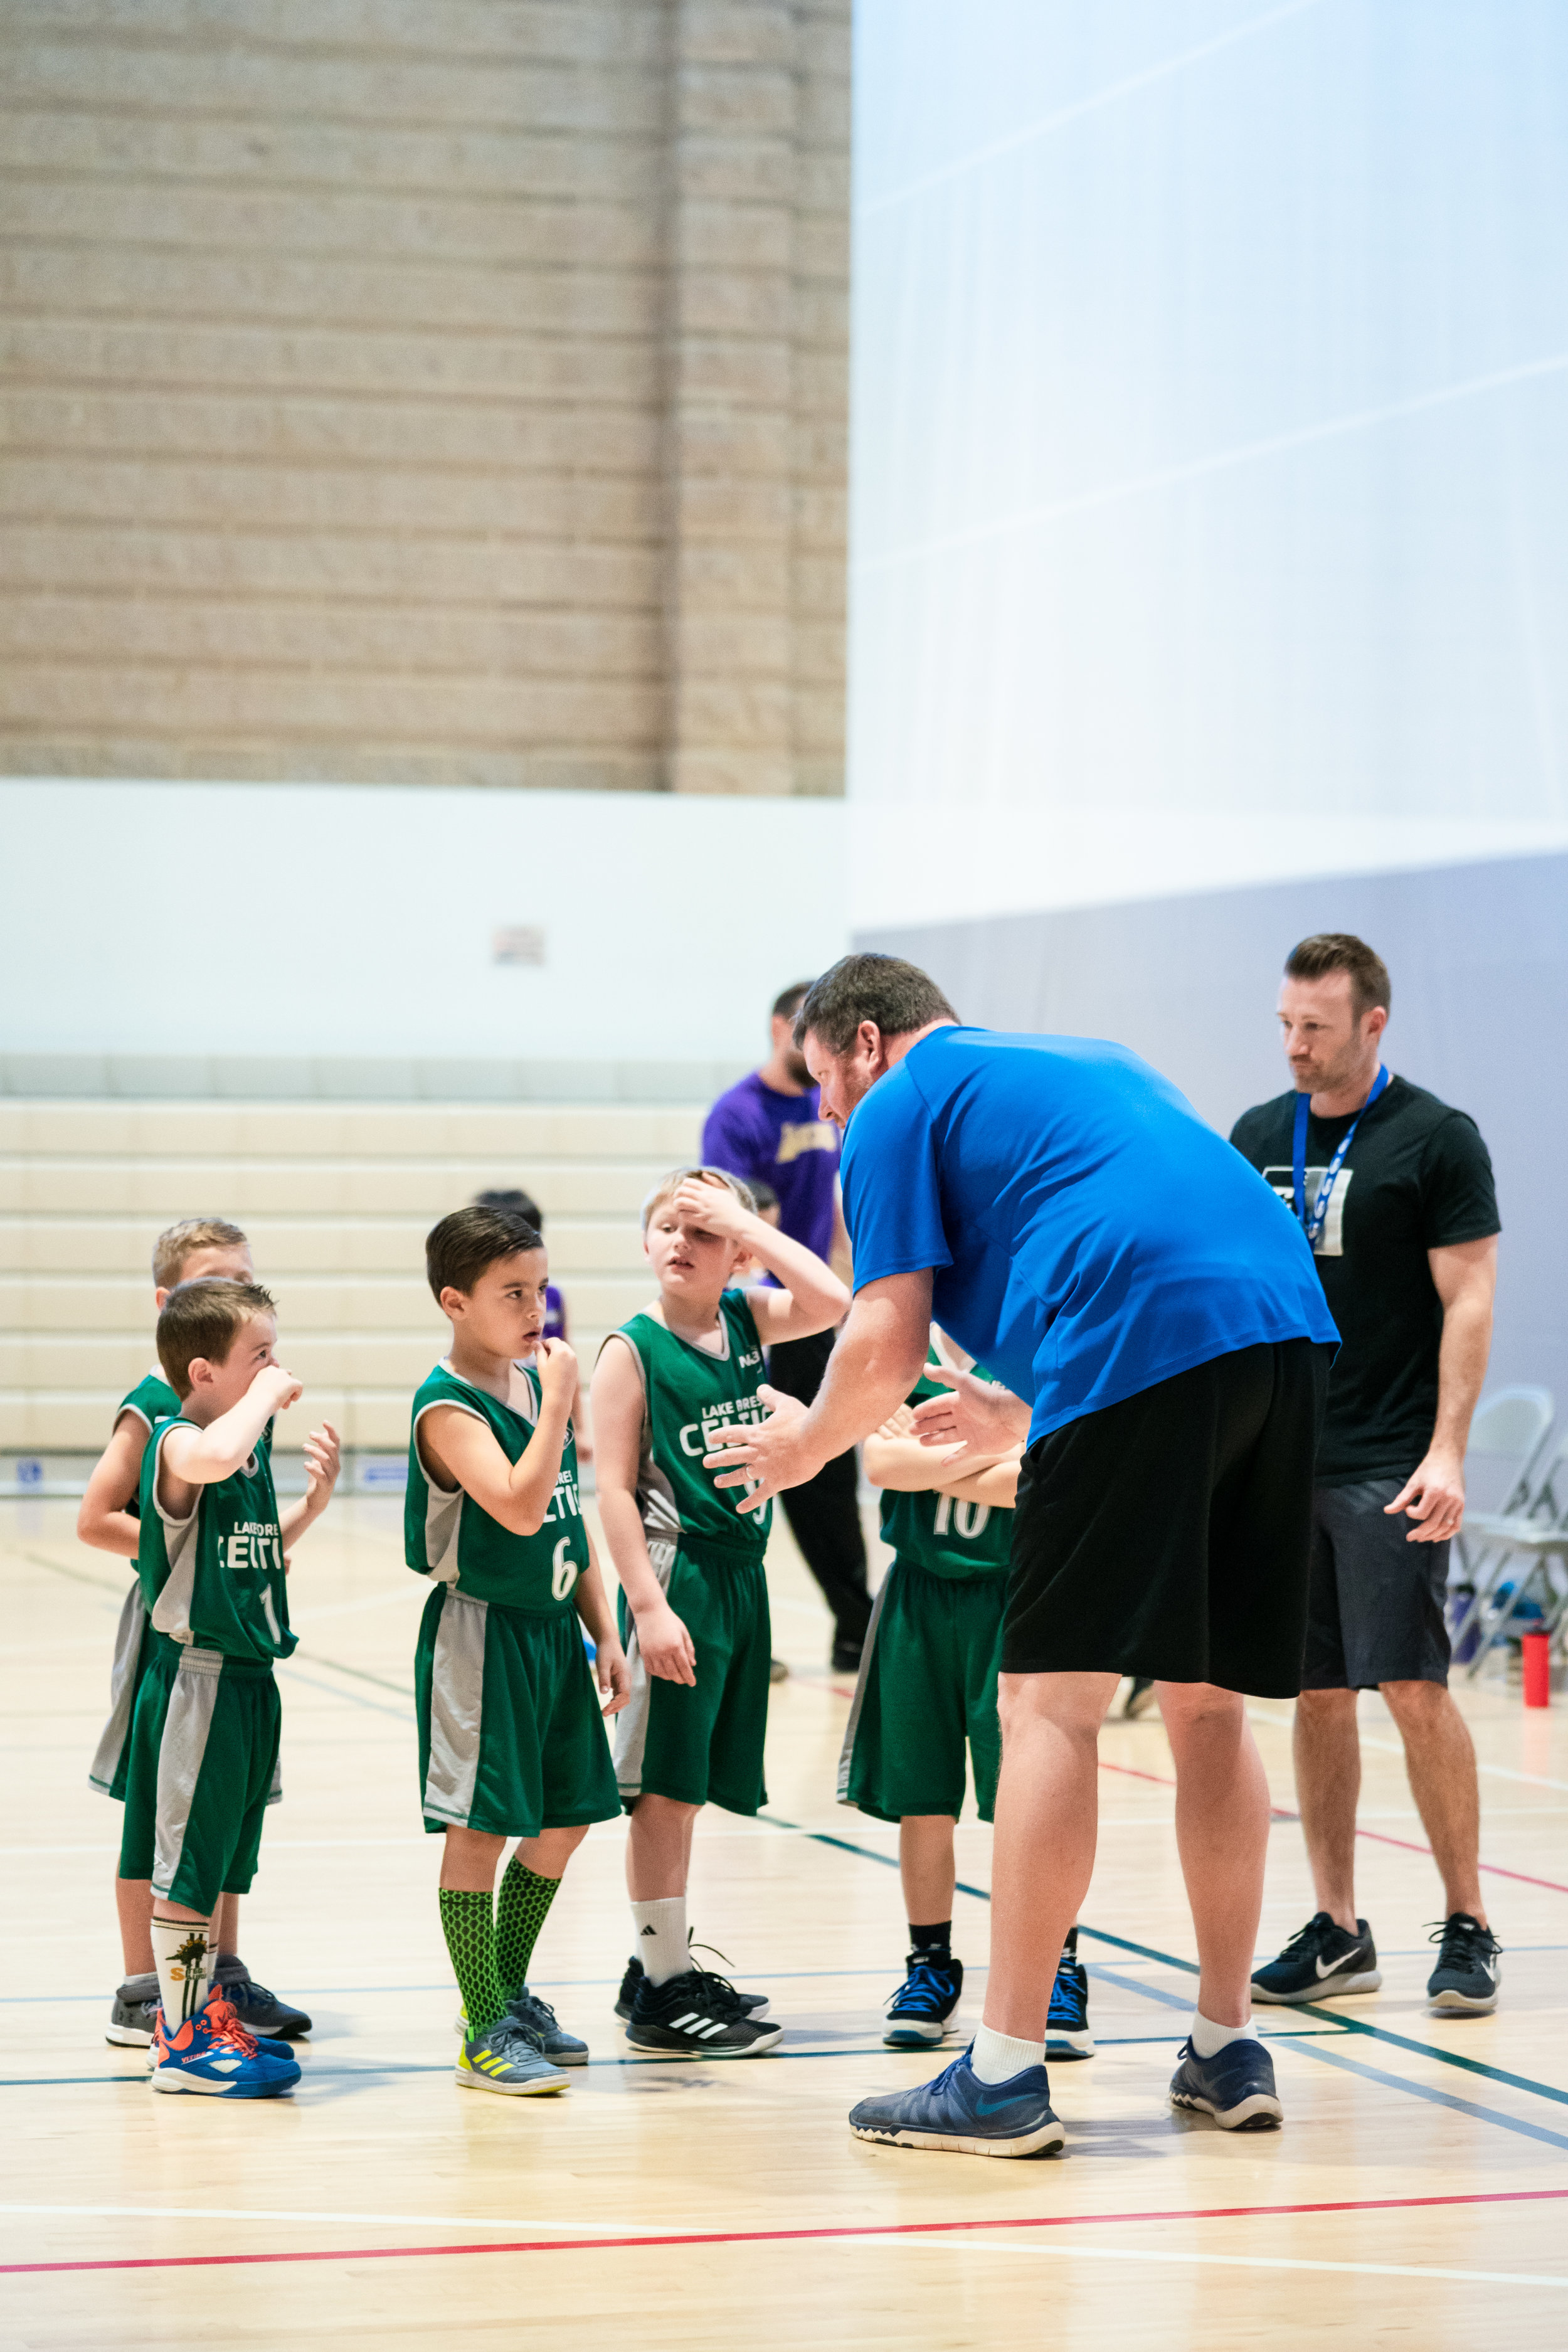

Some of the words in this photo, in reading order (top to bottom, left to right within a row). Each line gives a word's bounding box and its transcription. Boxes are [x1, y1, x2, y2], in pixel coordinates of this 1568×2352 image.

[702, 1401, 734, 1419] LAKE
[933, 1491, 992, 1539] 10
[551, 1535, 578, 1601] 6
[259, 1582, 282, 1645] 1
